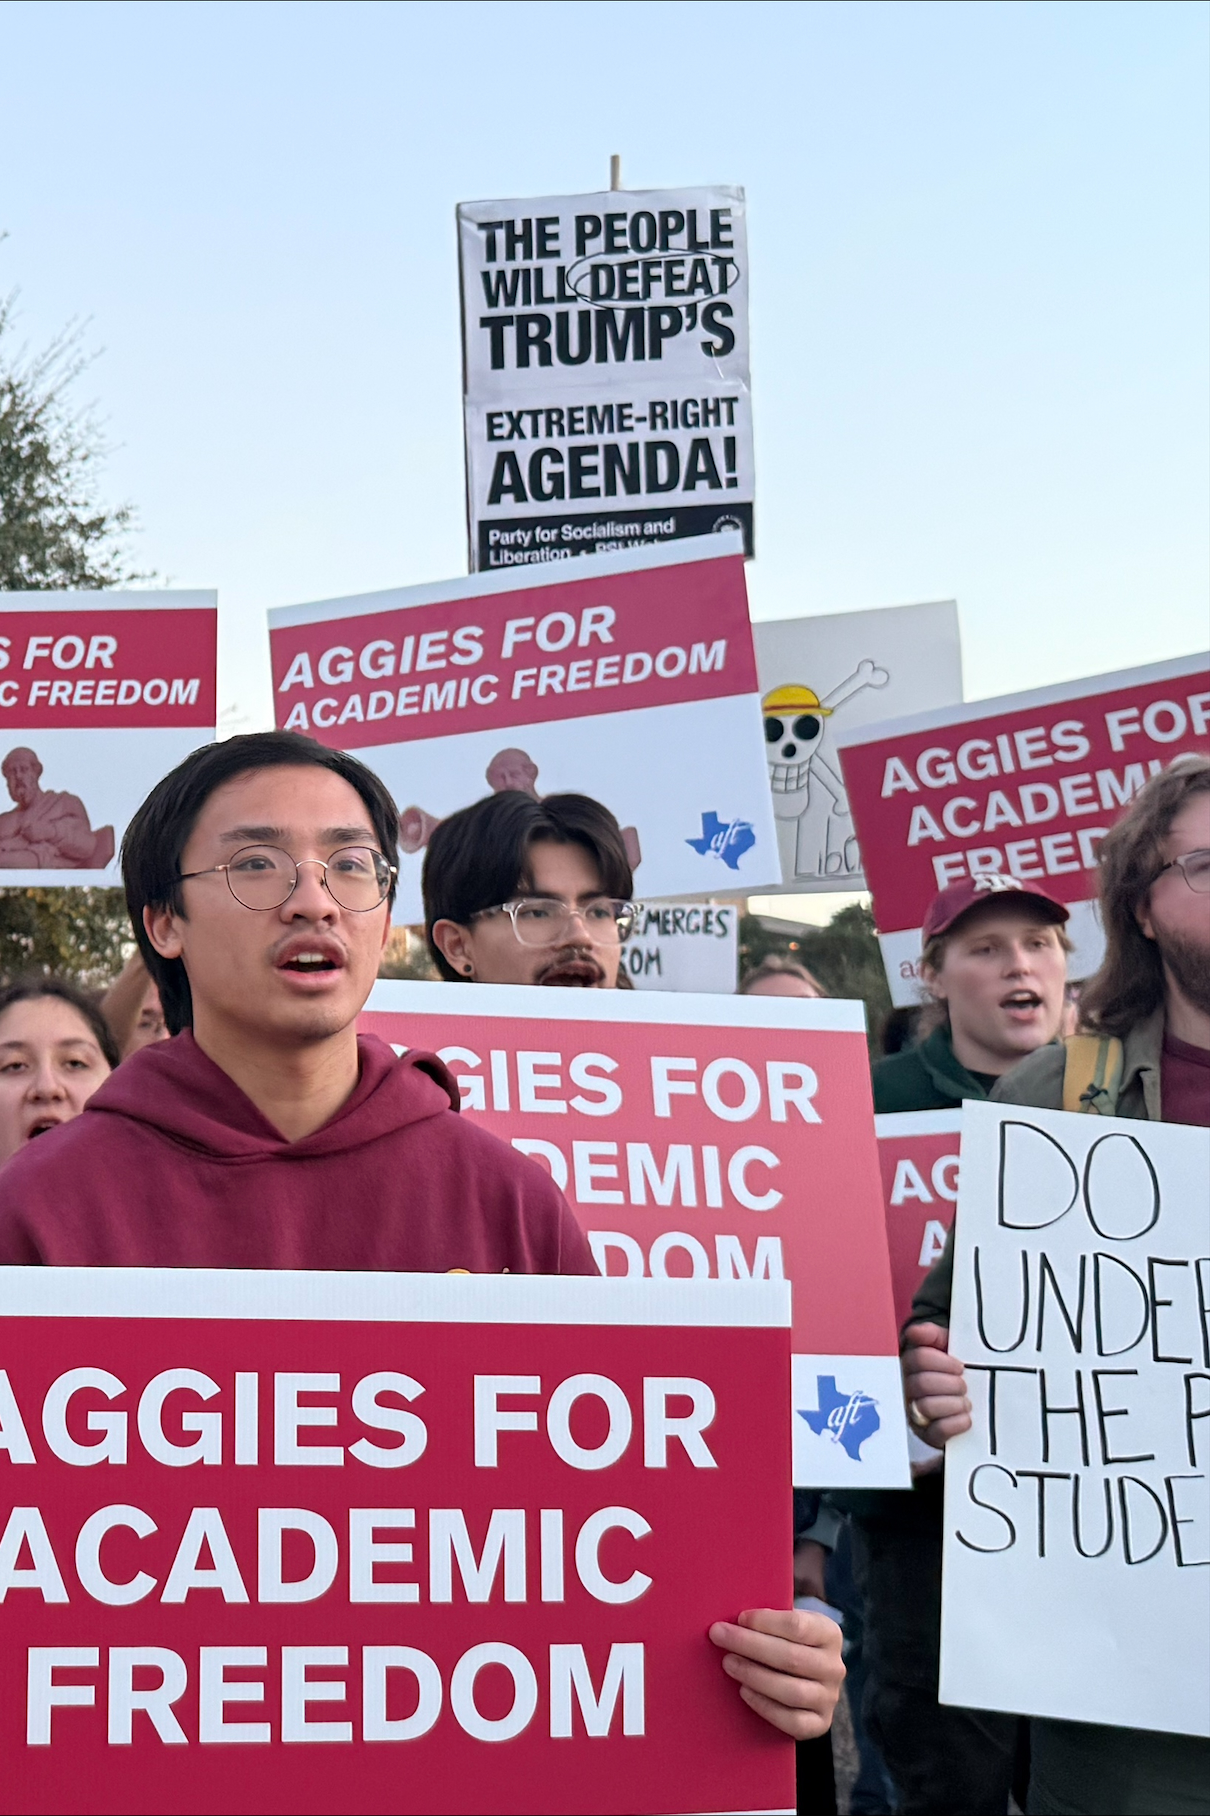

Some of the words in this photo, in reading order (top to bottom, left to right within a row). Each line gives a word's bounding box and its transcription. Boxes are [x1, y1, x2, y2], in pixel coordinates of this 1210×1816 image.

[477, 214, 561, 262] THE
[575, 209, 734, 257] PEOPLE
[480, 266, 574, 309] WILL
[590, 256, 733, 302] DEFEAT
[479, 301, 736, 371] TRUMP'S
[486, 397, 738, 442] EXTREME-RIGHT
[487, 436, 738, 506] AGENDA!
[489, 528, 531, 547] Party
[534, 526, 558, 542] for
[561, 521, 641, 541] Socialism
[643, 517, 676, 535] and
[489, 541, 571, 565] Liberation
[23, 635, 118, 670] FOR
[279, 625, 485, 692] AGGIES
[501, 605, 616, 659] FOR
[27, 678, 200, 706] FREEDOM
[283, 673, 499, 730] ACADEMIC
[511, 639, 726, 699] FREEDOM
[881, 720, 1090, 798] AGGIES
[390, 1044, 623, 1116] GIES
[650, 1056, 822, 1124] FOR
[998, 1120, 1161, 1241] DO
[474, 1373, 718, 1470] FOR
[827, 1391, 879, 1444] aft
[963, 1363, 1156, 1467] THE
[26, 1642, 646, 1746] FREEDOM
